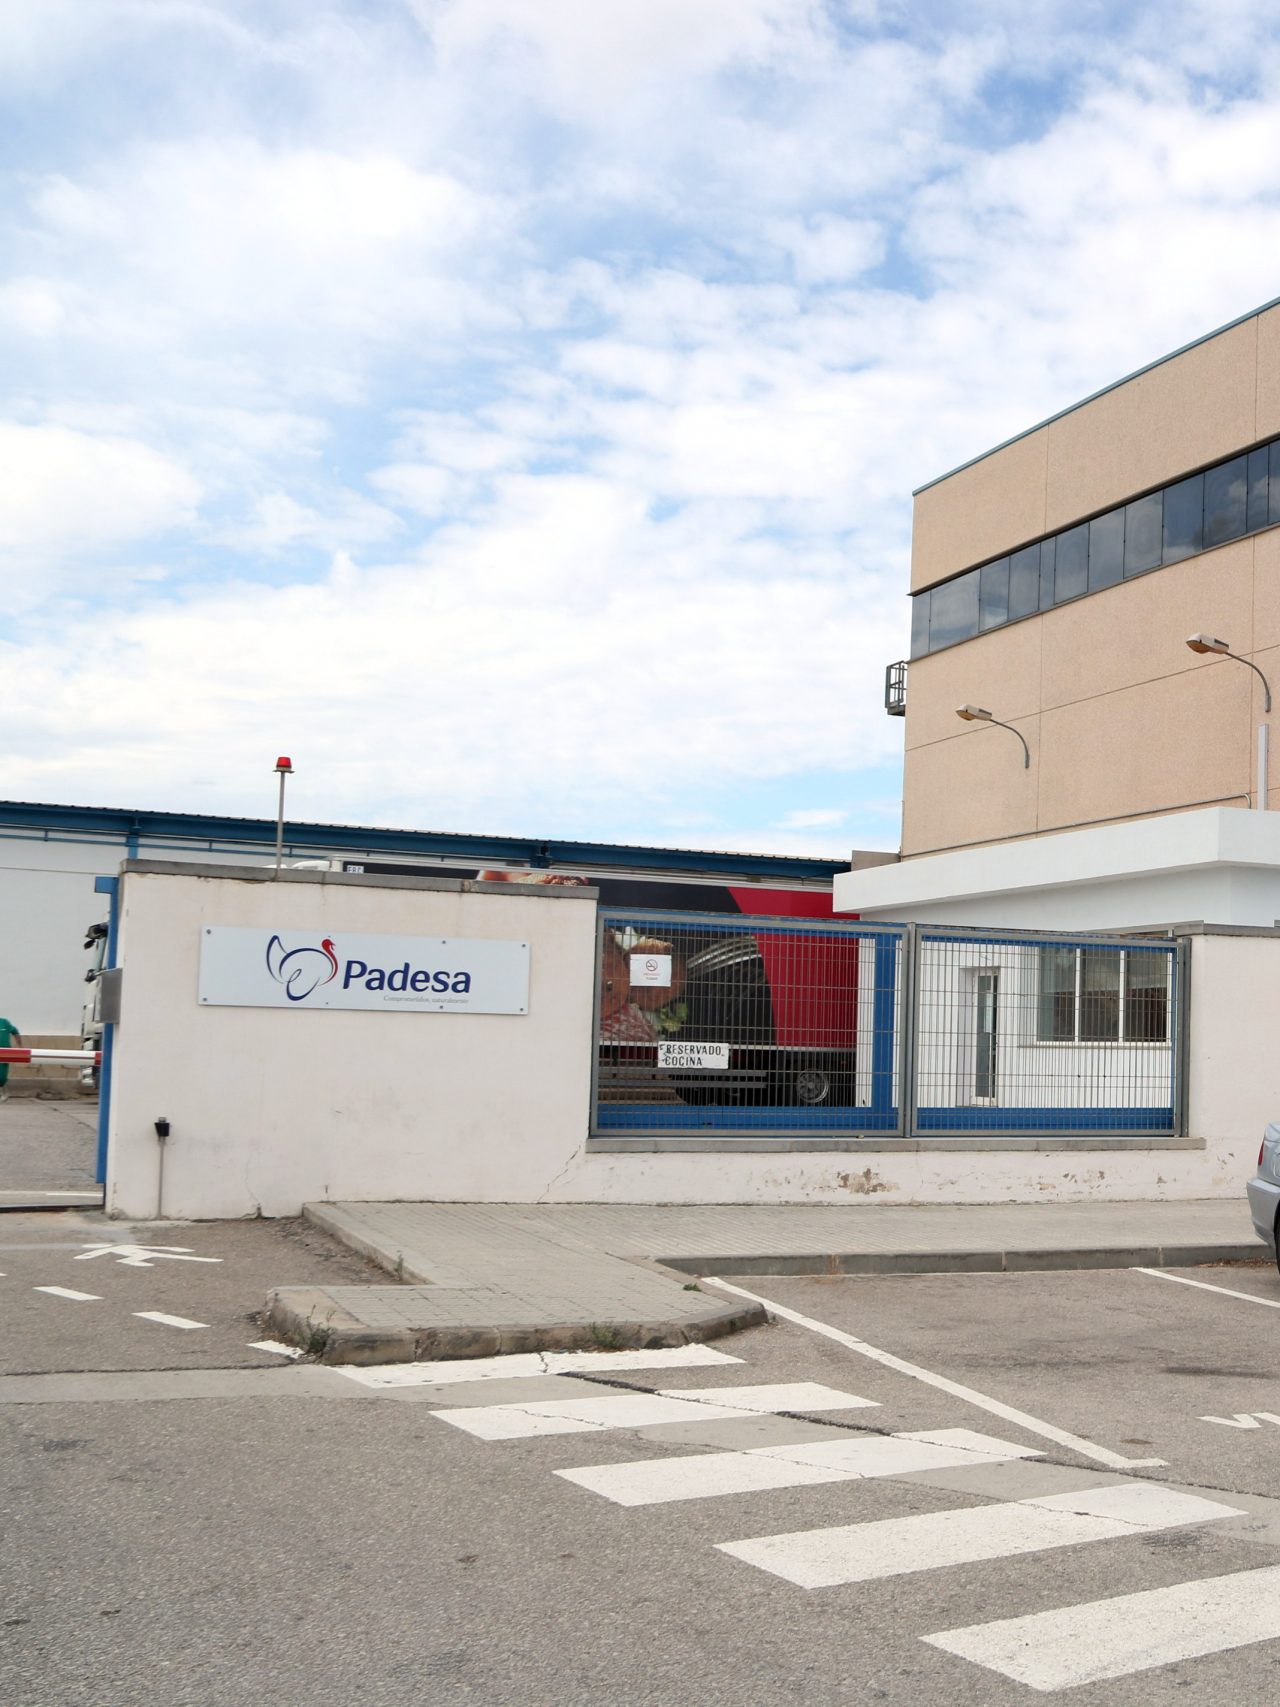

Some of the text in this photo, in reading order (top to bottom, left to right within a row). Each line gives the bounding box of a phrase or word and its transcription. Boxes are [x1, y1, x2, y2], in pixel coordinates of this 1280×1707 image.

[343, 960, 471, 993] Padesa
[666, 1044, 721, 1056] RESERVADO
[665, 1056, 703, 1067] COCINA
